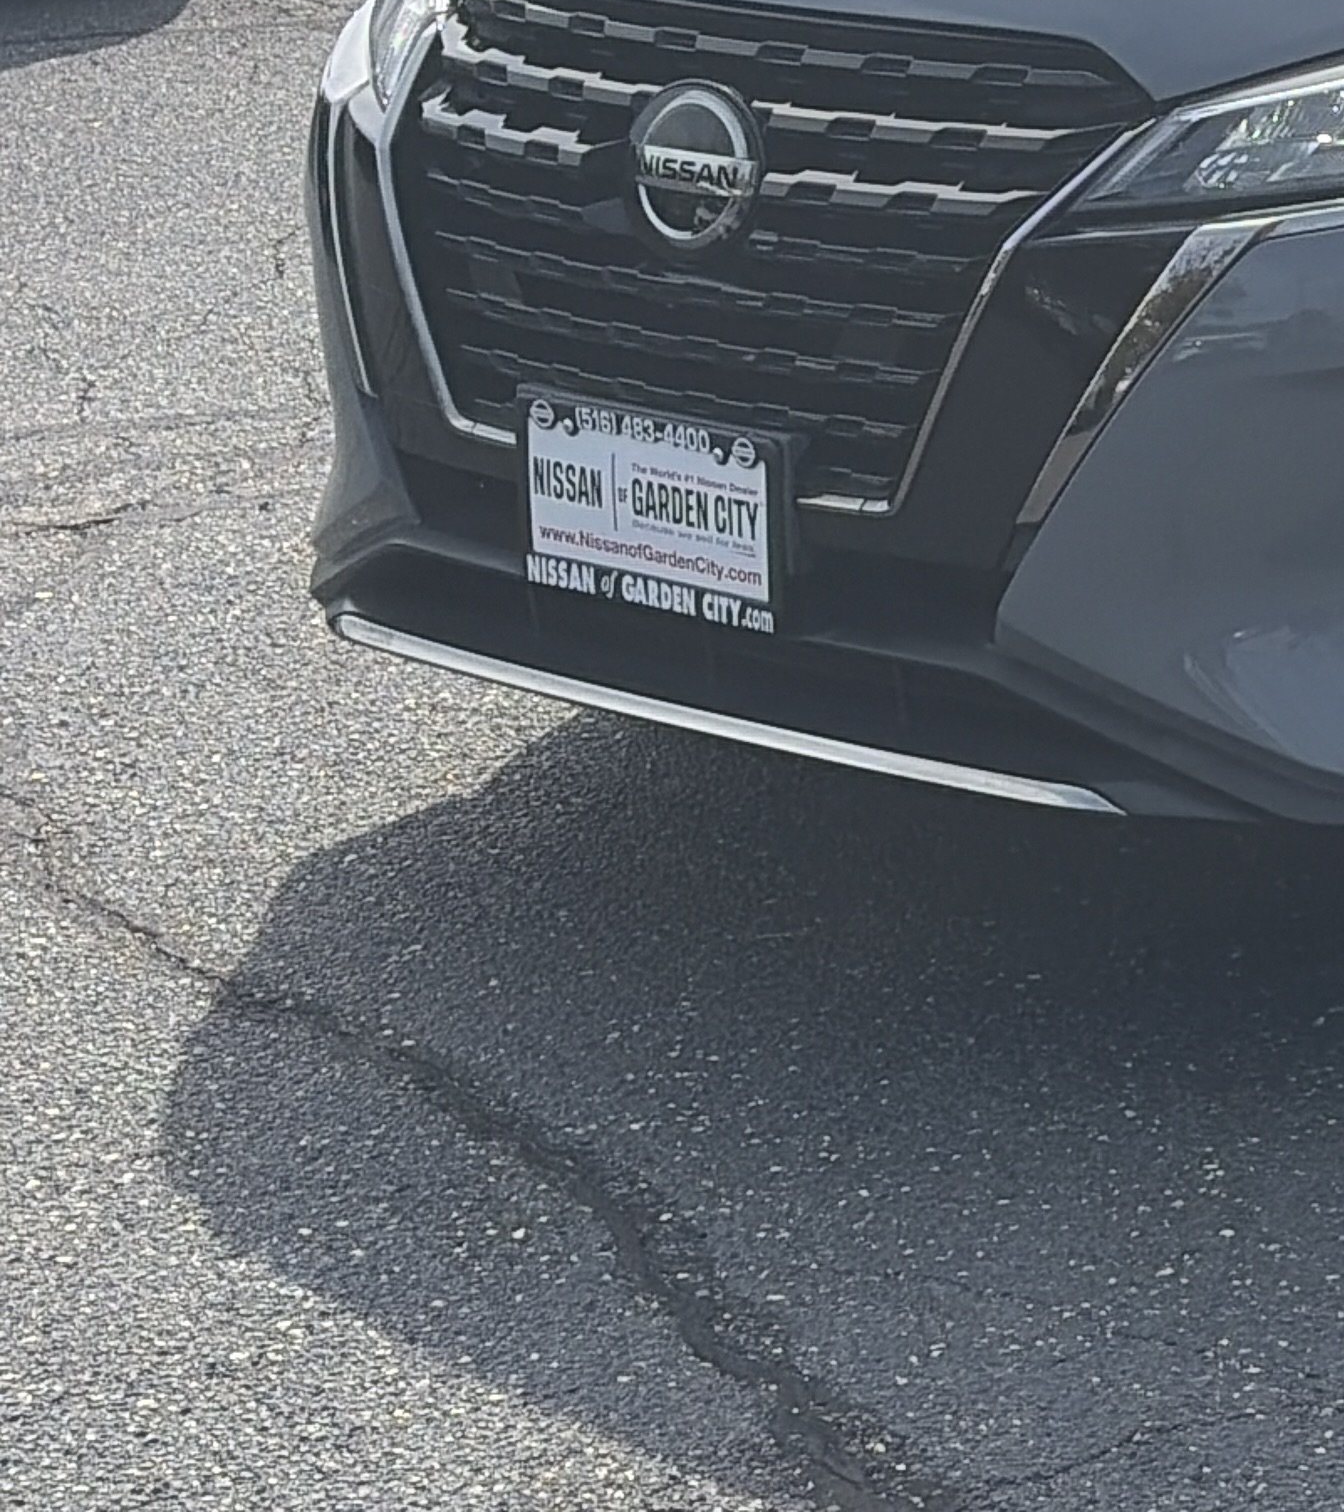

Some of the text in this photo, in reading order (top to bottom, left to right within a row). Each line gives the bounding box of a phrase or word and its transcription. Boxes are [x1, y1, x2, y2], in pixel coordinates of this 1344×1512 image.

[641, 154, 739, 188] NISSAN
[575, 407, 711, 453] (516) 483-4400
[533, 456, 603, 508] NISSAN
[631, 462, 648, 474] The
[631, 478, 709, 531] GARDEN
[714, 494, 759, 541] CITY
[539, 525, 763, 586] www.NissanofGardenCity.com
[526, 553, 775, 634] NISSAN of GARDEN CITY.com
